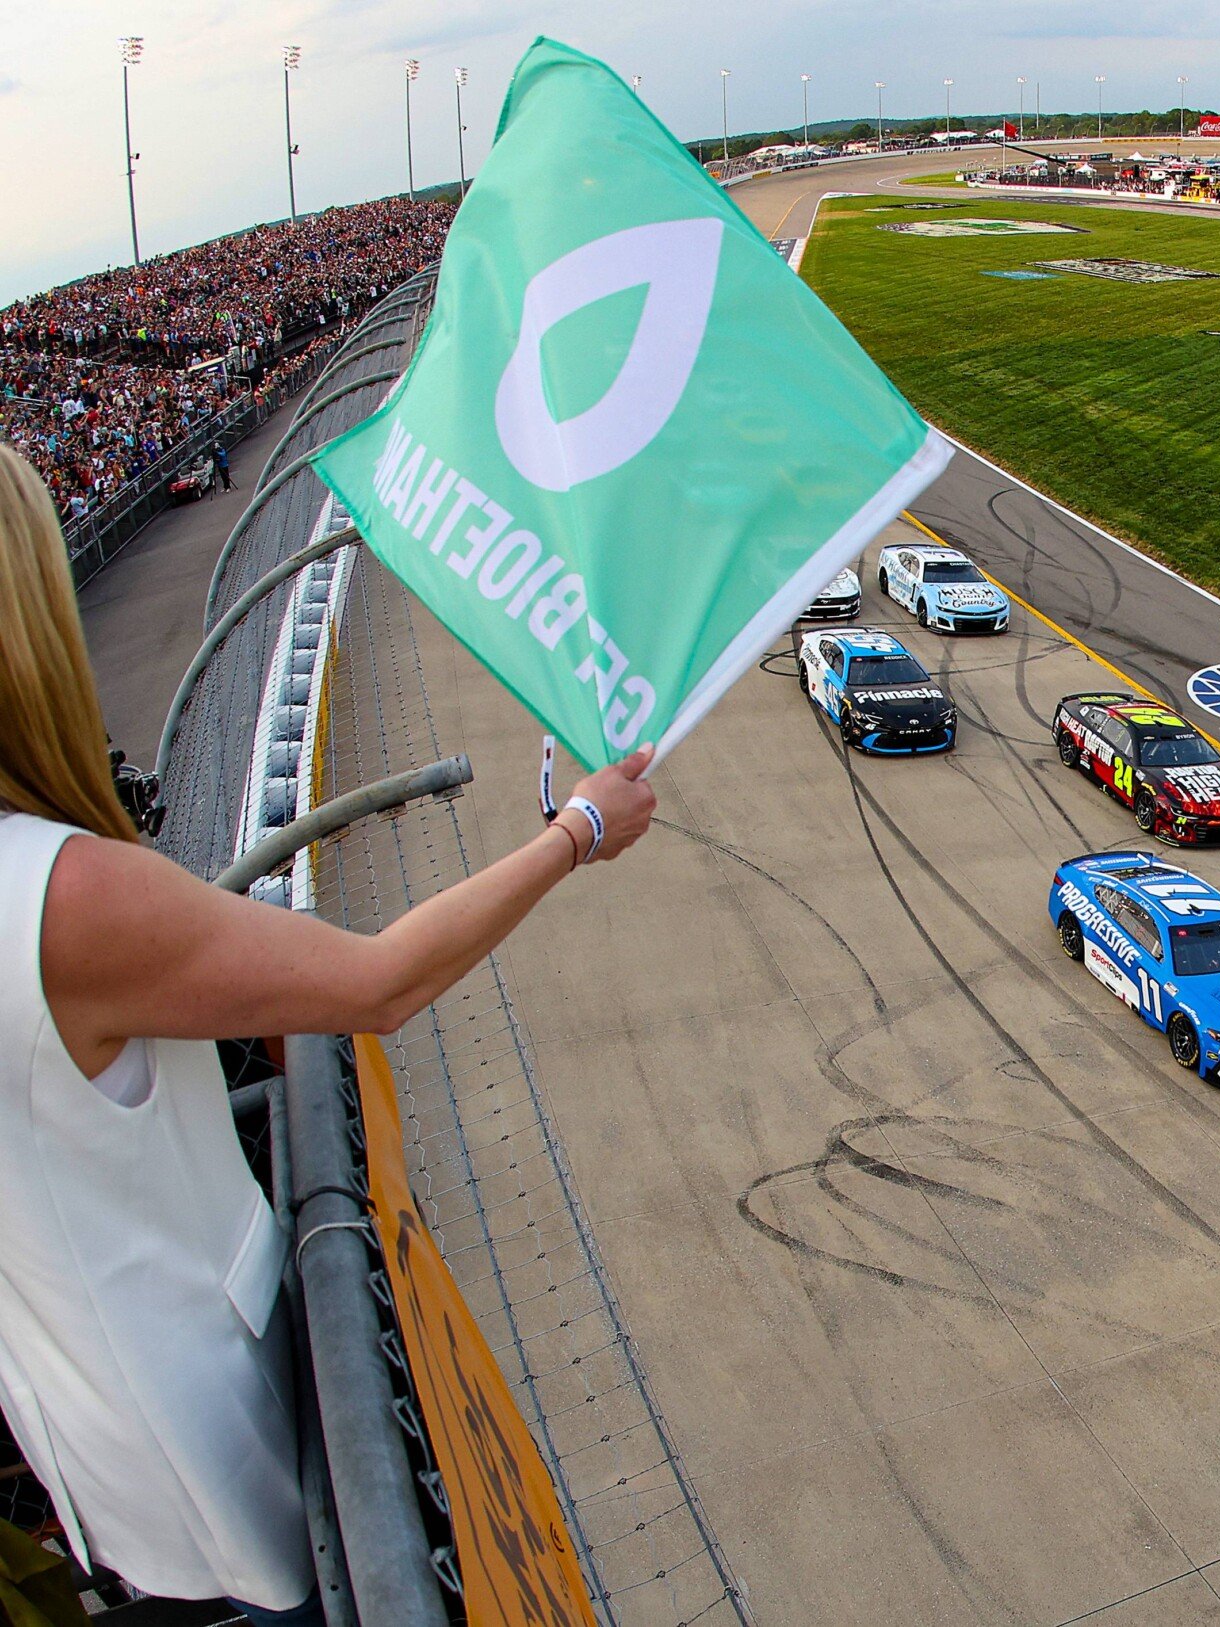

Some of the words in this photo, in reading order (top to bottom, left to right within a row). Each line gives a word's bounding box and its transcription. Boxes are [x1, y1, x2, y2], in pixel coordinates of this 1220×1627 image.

[853, 687, 943, 704] Pinnacle
[1067, 716, 1086, 737] HEAT
[1114, 756, 1133, 798] 24
[1057, 880, 1142, 968] PROGRESSIVE
[1137, 967, 1163, 1024] 11
